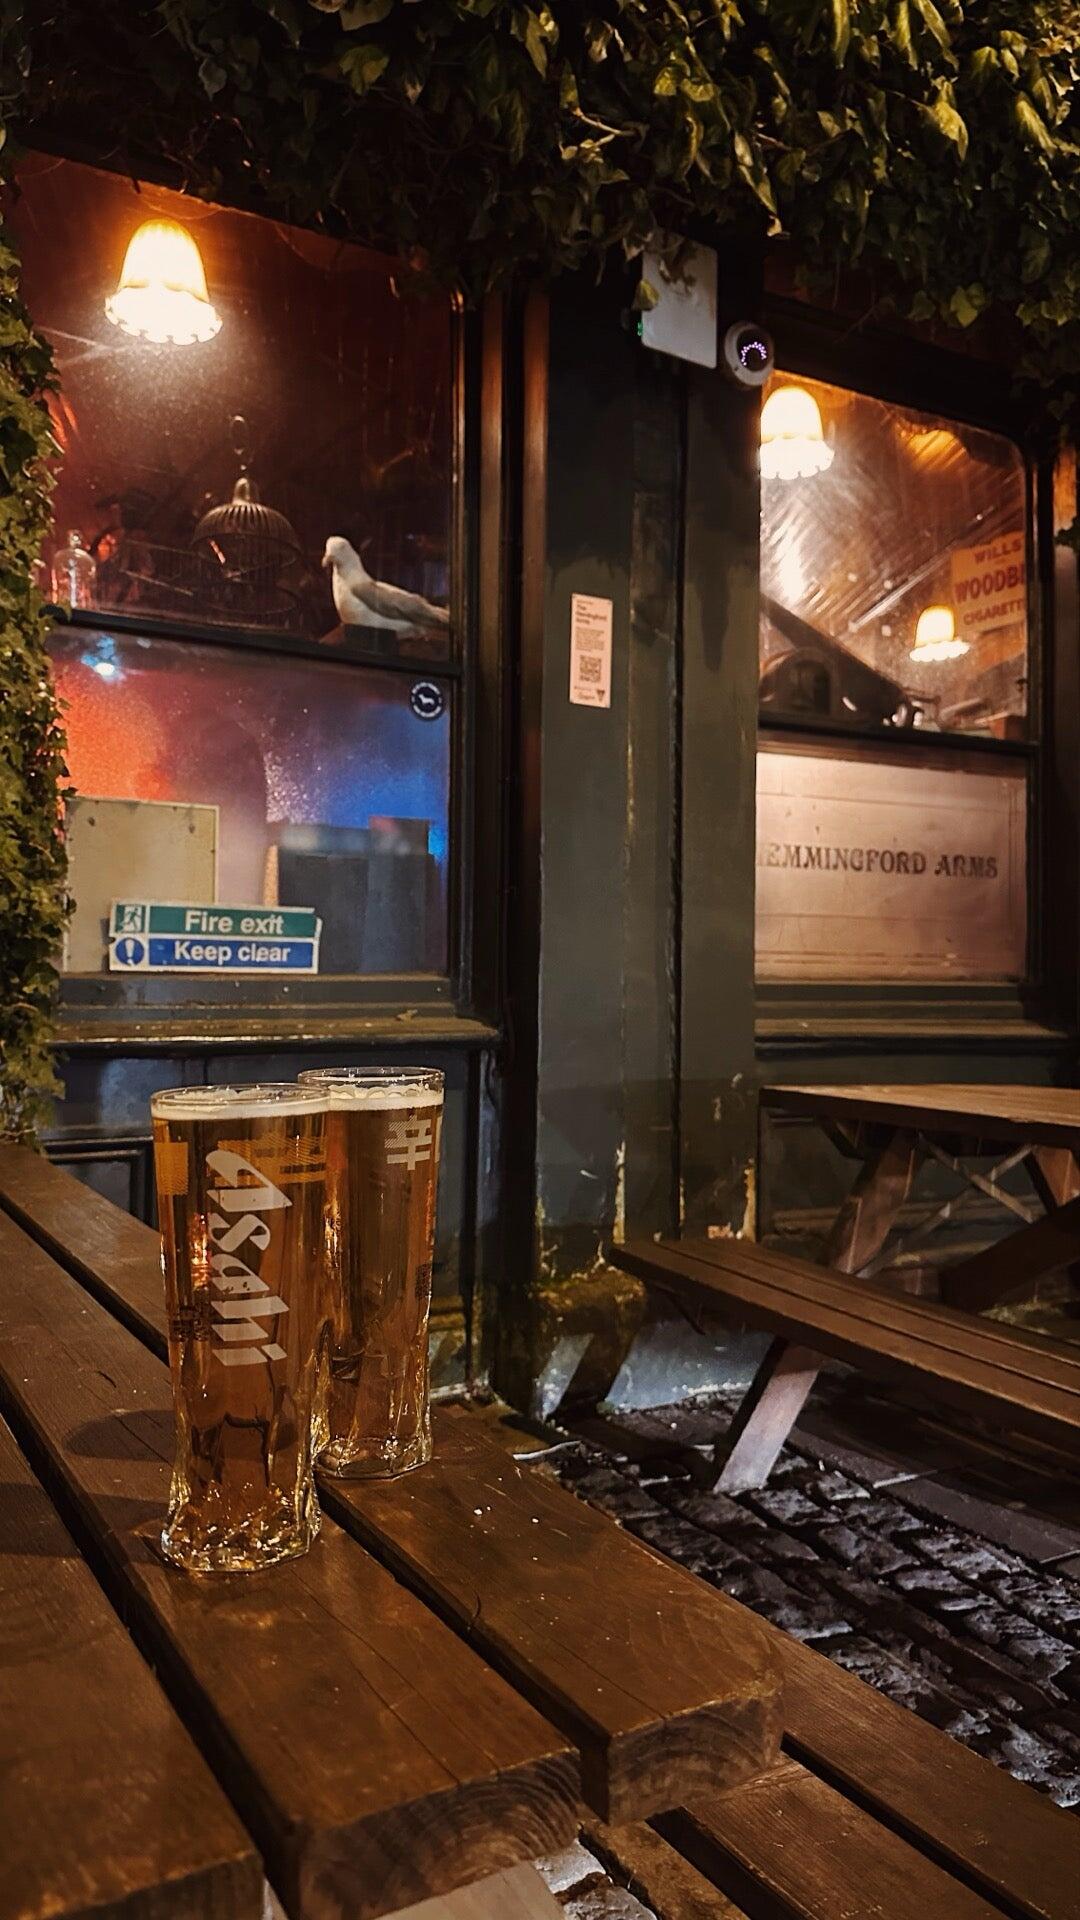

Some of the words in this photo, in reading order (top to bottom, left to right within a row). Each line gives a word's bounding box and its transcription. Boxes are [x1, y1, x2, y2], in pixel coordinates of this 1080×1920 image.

[934, 854, 998, 879] ARMS
[184, 910, 232, 933] Fire
[240, 914, 284, 935] exit
[174, 941, 232, 965] Keep
[237, 944, 291, 962] clear
[205, 1149, 293, 1367] Asahi
